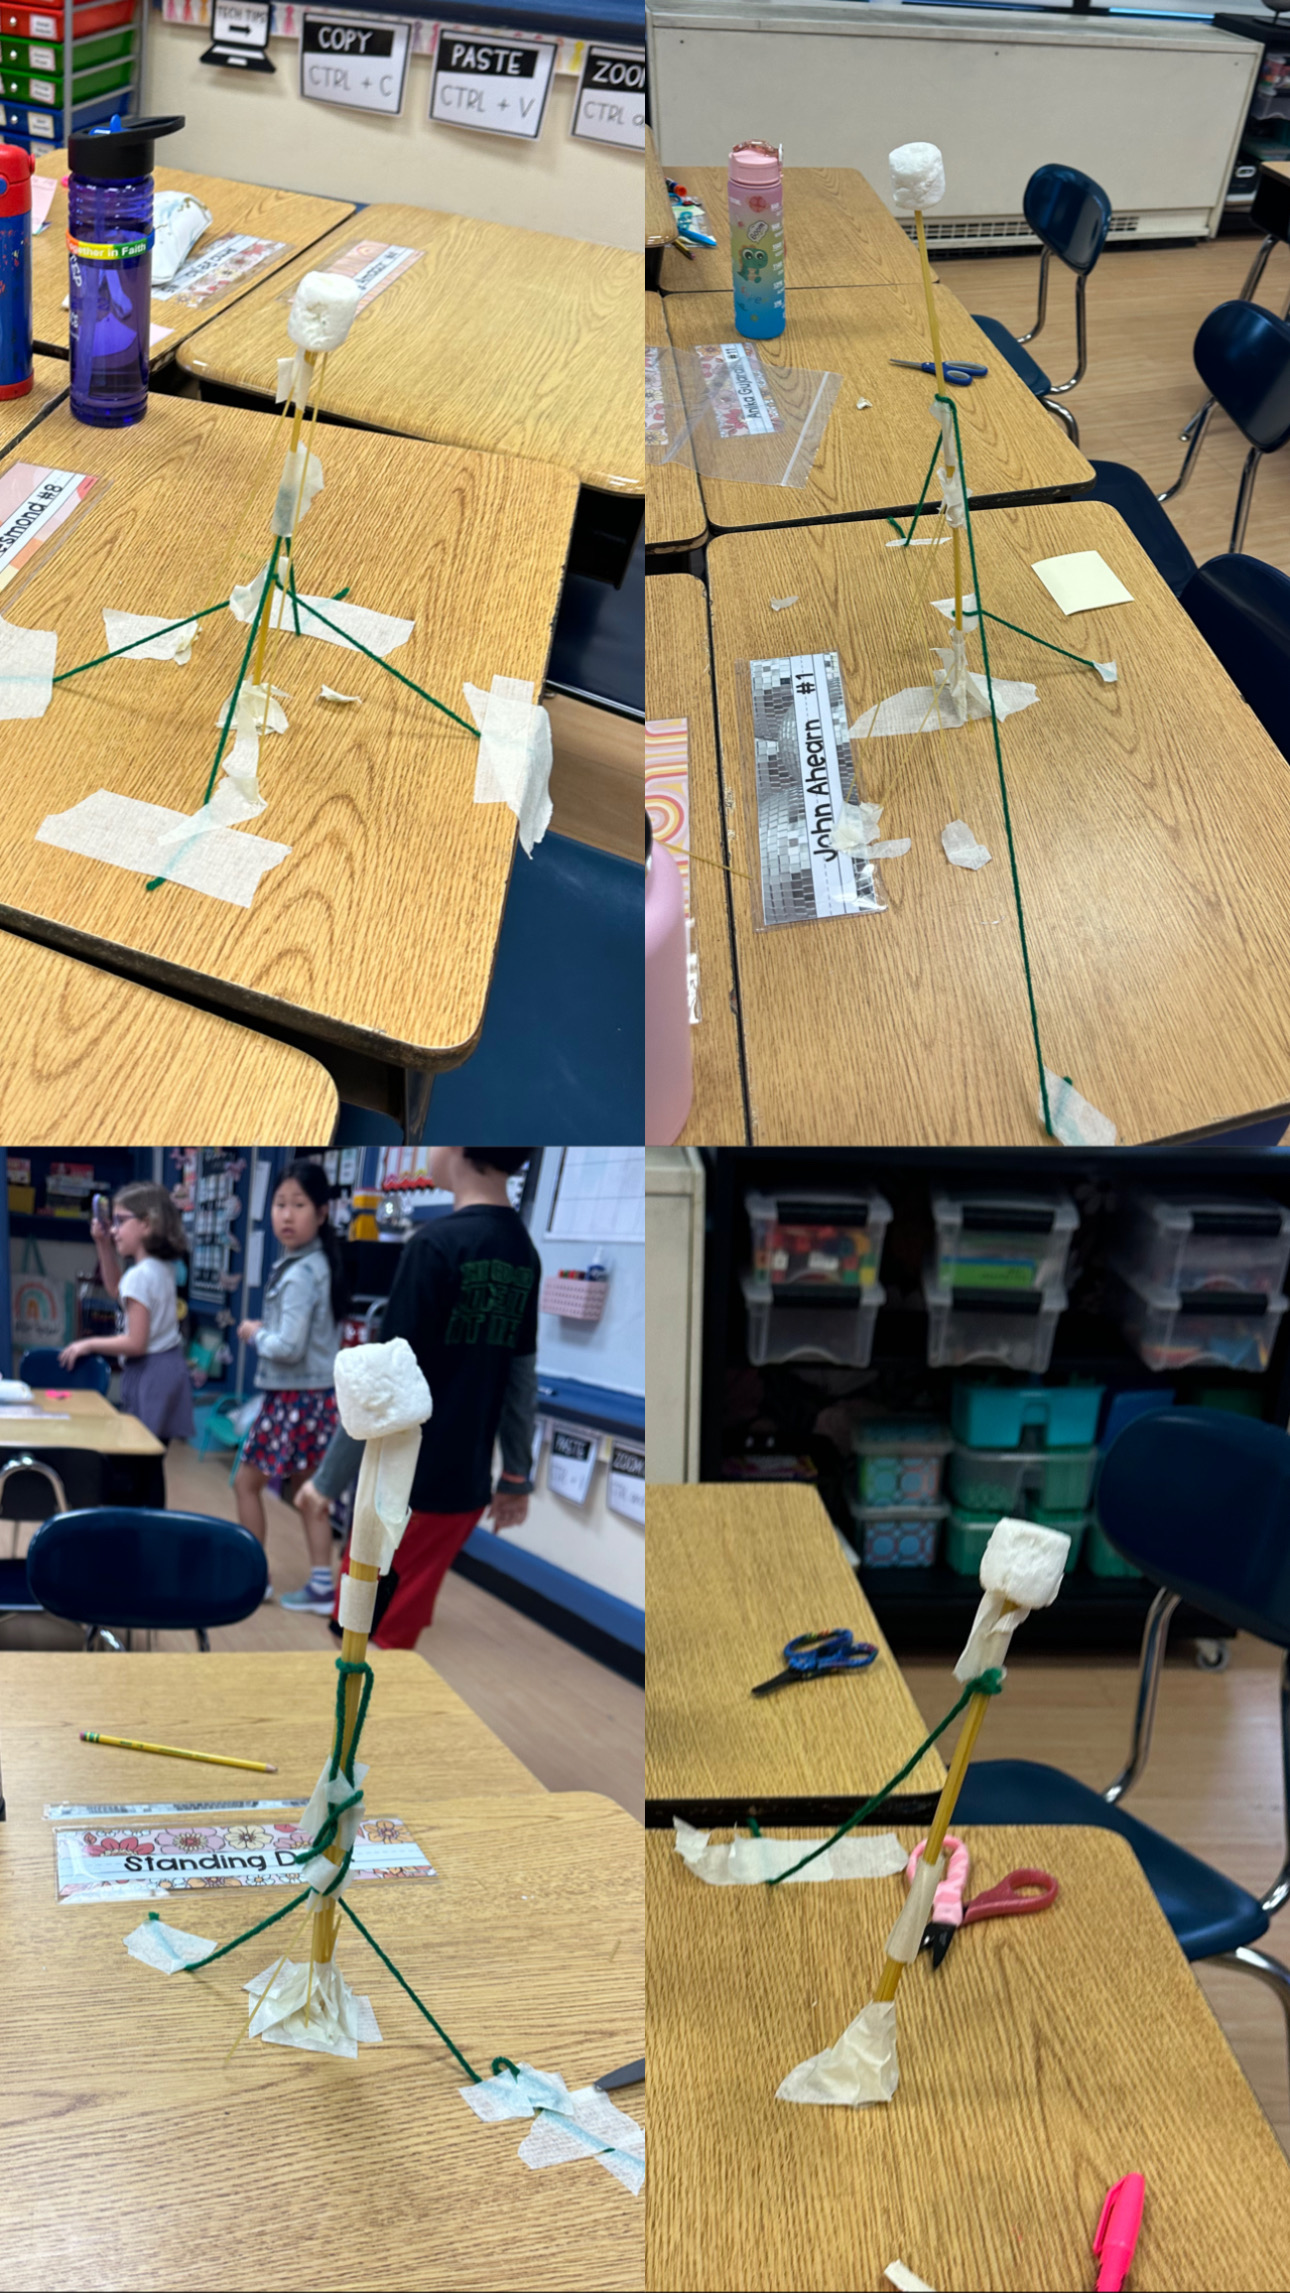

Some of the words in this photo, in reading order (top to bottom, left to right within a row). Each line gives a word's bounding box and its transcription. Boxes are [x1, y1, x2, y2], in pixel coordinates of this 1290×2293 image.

[216, 5, 243, 20] TECH
[245, 9, 267, 24] TIPS
[317, 26, 373, 53] COPY
[451, 43, 524, 75] PASTE
[308, 65, 351, 91] CTRL
[379, 75, 393, 97] C
[440, 84, 486, 113] CTRL
[519, 96, 536, 119] V
[583, 101, 626, 125] CTRL
[107, 245, 119, 257] in
[121, 241, 147, 256] Faith
[743, 396, 762, 419] Anika
[37, 483, 63, 500] #8
[794, 673, 816, 695] #1
[805, 719, 830, 796] Ahearn
[810, 803, 838, 863] John
[123, 1853, 268, 1872] Standing
[274, 1850, 298, 1868] D
